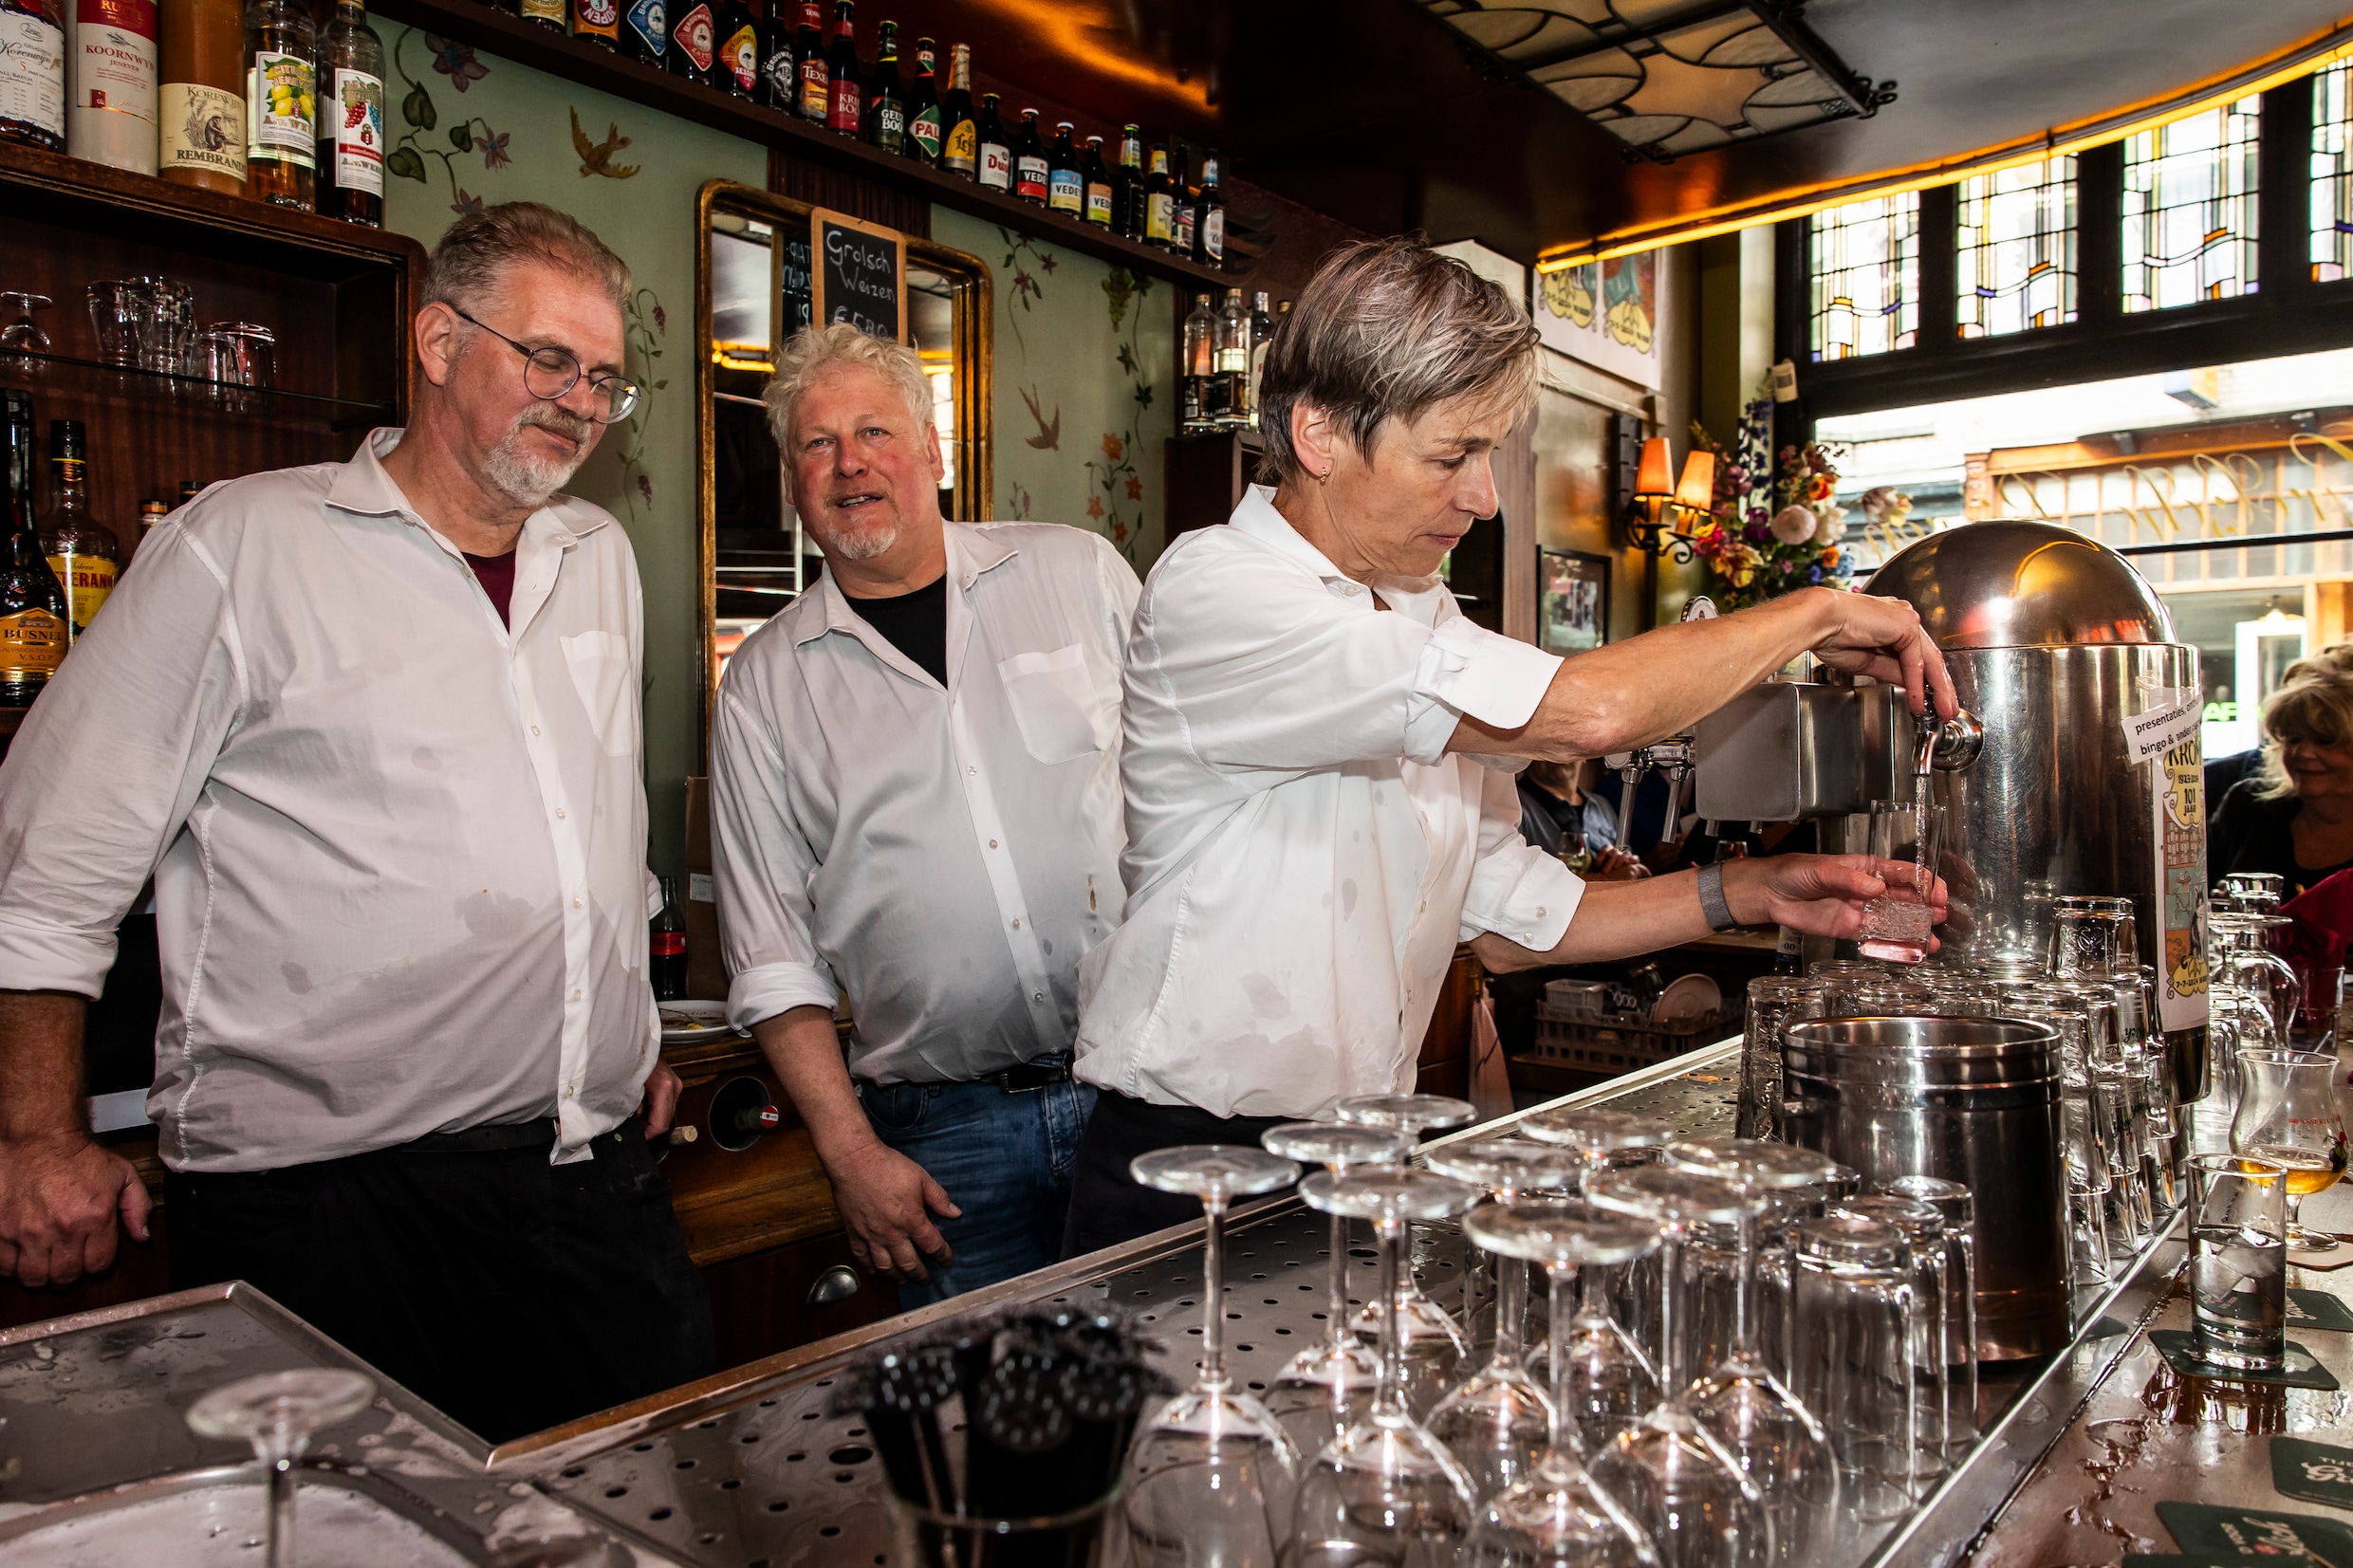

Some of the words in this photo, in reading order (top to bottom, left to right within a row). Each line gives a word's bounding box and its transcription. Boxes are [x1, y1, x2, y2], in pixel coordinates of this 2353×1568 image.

[584, 6, 617, 24] JOPEN
[19, 61, 27, 71] 5
[109, 59, 139, 72] JENEVER
[826, 230, 891, 274] Grolsch
[839, 265, 896, 304] Weizen
[55, 571, 113, 589] TERAN
[4, 629, 63, 641] BUSNEL
[2135, 708, 2187, 736] presentaties,
[2140, 739, 2167, 756] bingo
[2168, 734, 2175, 745] &
[2184, 787, 2196, 804] 101
[2183, 804, 2196, 816] JAAR
